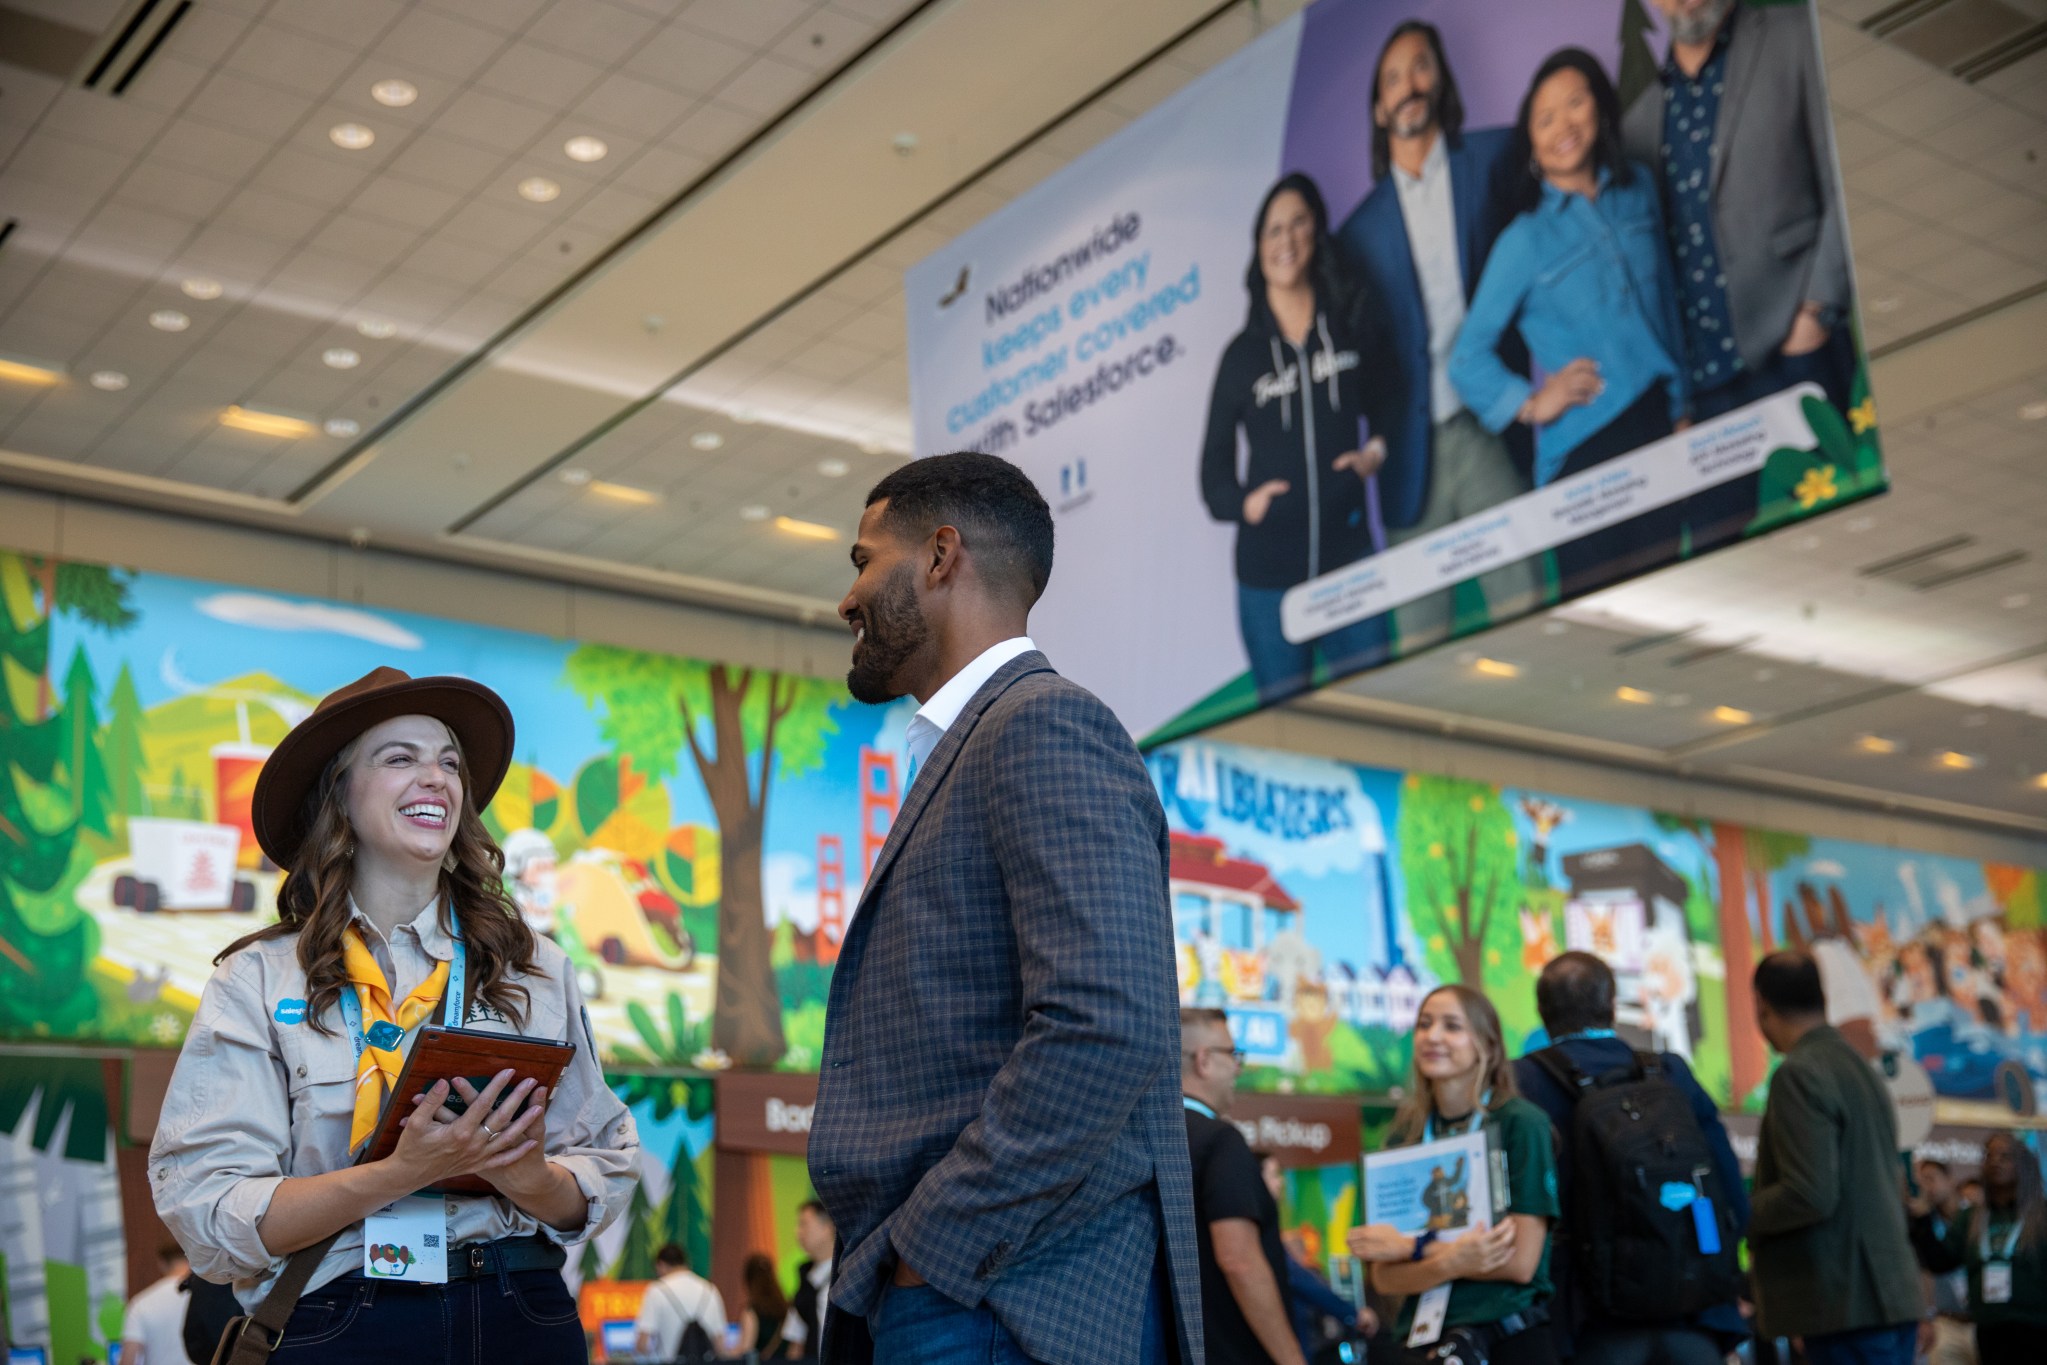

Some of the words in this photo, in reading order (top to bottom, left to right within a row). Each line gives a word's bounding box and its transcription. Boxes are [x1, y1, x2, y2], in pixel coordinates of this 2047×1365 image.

[982, 304, 1063, 369] keeps
[1068, 250, 1152, 319] every
[986, 211, 1141, 326] Nationwide
[947, 343, 1068, 434] customer
[1075, 262, 1200, 362] covered
[1023, 333, 1185, 437] Salesforce.
[453, 990, 462, 1027] dreamforce
